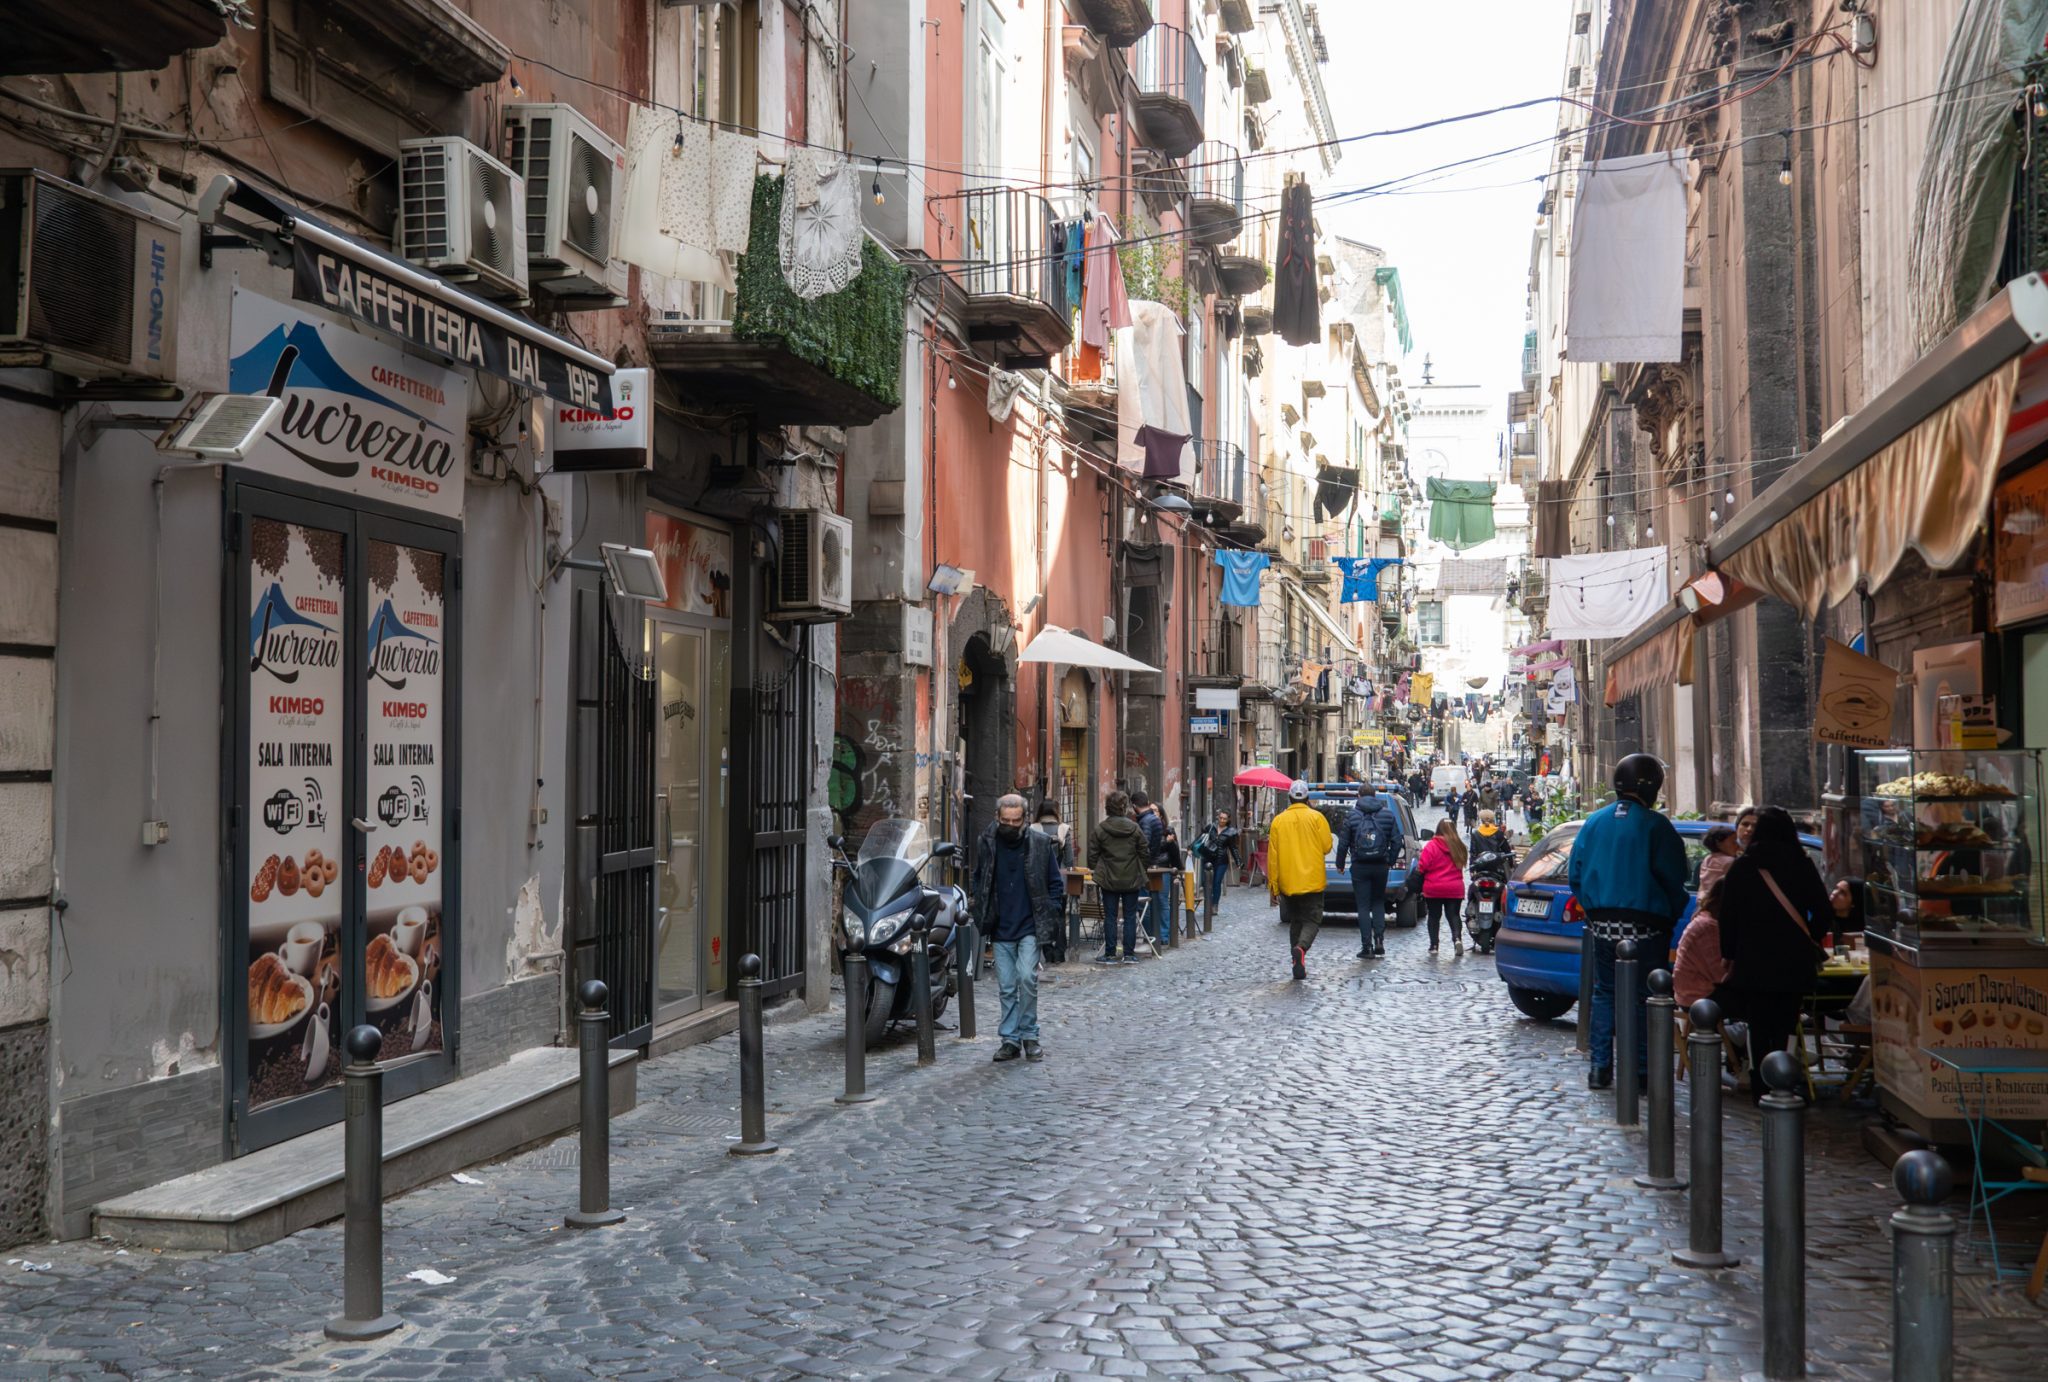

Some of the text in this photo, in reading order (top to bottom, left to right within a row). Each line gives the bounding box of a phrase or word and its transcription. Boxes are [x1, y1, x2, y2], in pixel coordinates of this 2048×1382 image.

[317, 254, 600, 411] CAFFETTERIA DAL 1912
[371, 365, 446, 406] CAFFETTERIA
[371, 465, 440, 494] KIMBO
[295, 595, 338, 616] CAFFETTERIA
[403, 610, 439, 628] CAFFETTERIA
[251, 602, 339, 684] Lucrezia
[367, 615, 440, 690] Lucrezia
[270, 696, 324, 715] KIMBO
[382, 701, 427, 719] KIMBO
[1818, 727, 1885, 746] Caffetteria
[258, 742, 332, 767] SALA INTERNA
[373, 743, 434, 766] SALA INTERNA
[1318, 799, 1357, 809] POLIZ
[1935, 982, 1976, 1014] Sapori
